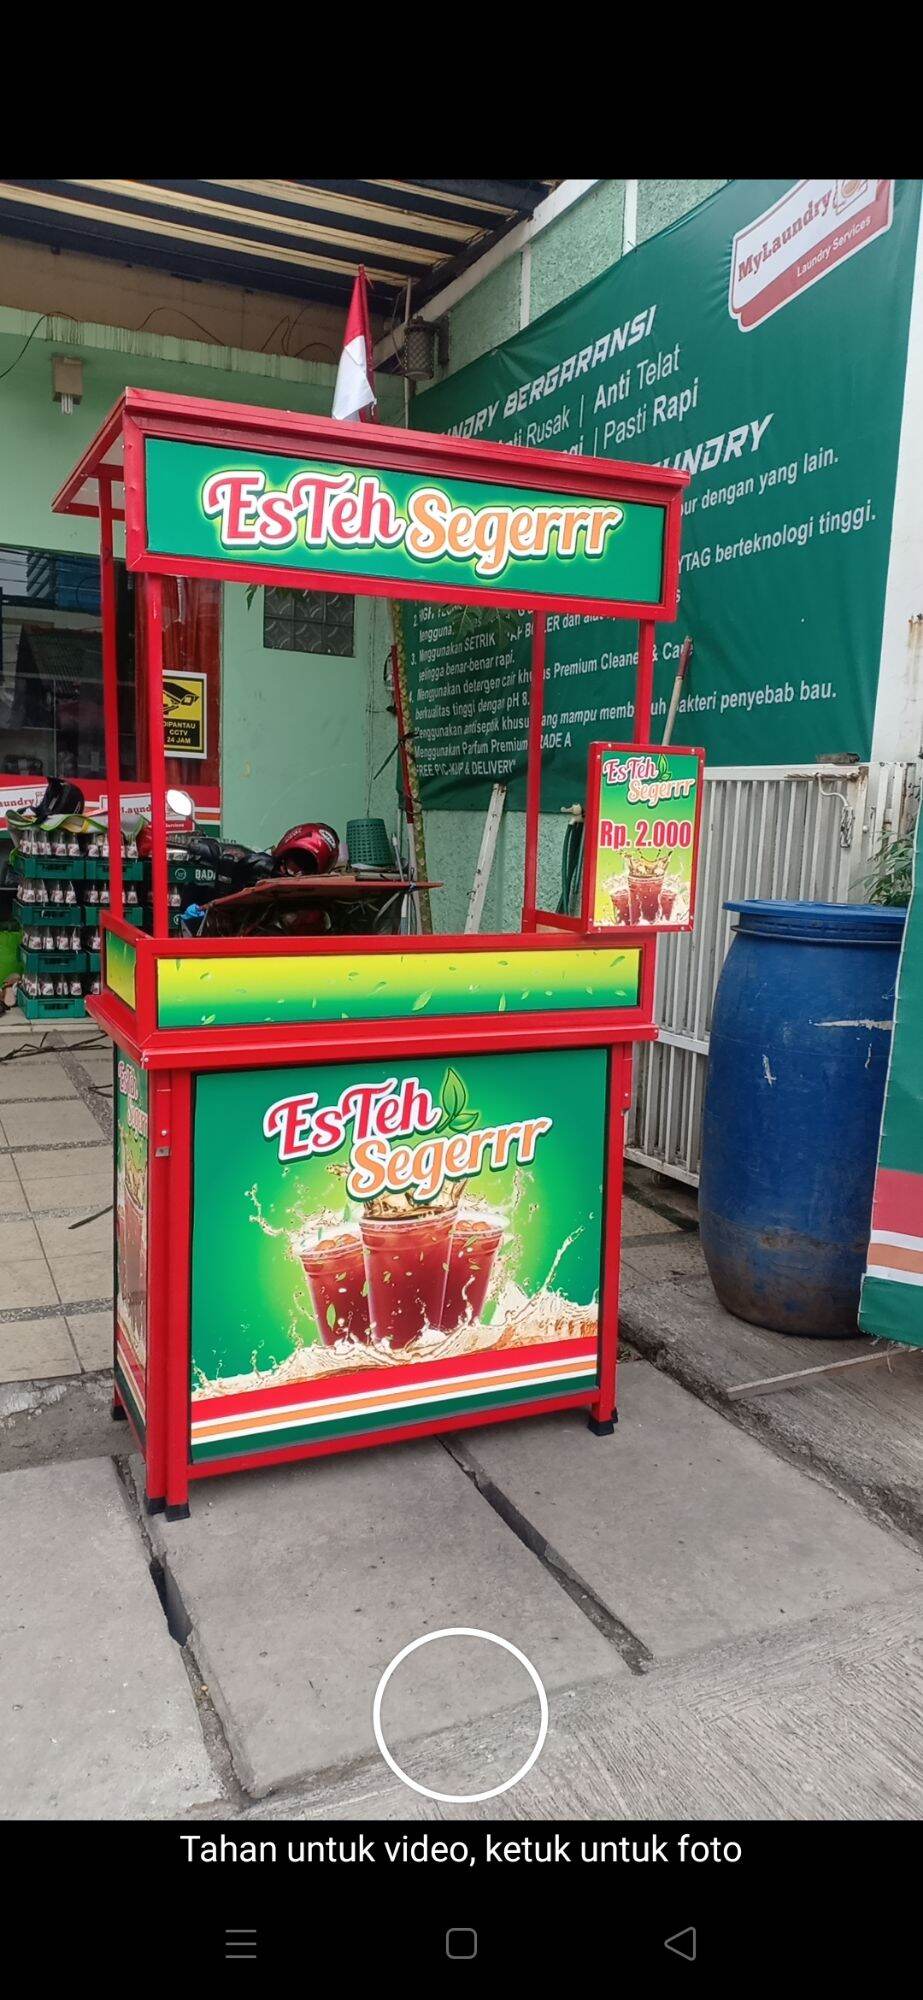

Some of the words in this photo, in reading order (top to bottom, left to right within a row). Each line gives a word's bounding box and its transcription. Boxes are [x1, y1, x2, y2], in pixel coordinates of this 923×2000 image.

[738, 190, 832, 282] MyLaundry
[797, 246, 832, 277] Laundry
[832, 216, 871, 250] Services
[503, 304, 657, 420] BERGARANSI
[526, 405, 570, 448] Rusak
[594, 369, 631, 414] Anti
[637, 342, 681, 390] Telat
[603, 403, 647, 450] Pasti
[653, 377, 699, 426] Rapi
[701, 477, 754, 510] dengan
[759, 461, 798, 495] yang
[803, 447, 839, 475] lain.
[406, 487, 622, 576] Segerrr
[715, 516, 815, 563] berteknologi
[819, 499, 876, 534] tinggi.
[495, 650, 515, 669] rapi.
[501, 671, 516, 687] cair
[554, 657, 597, 679] Premium
[453, 702, 476, 718] tinggi
[507, 691, 519, 711] pH
[560, 708, 597, 727] mampu
[720, 682, 794, 713] penyebab
[800, 680, 837, 701] bau.
[166, 736, 175, 744] 24
[169, 729, 188, 737] CCTV
[462, 740, 488, 755] Parfum
[491, 737, 528, 753] Premium
[564, 732, 572, 748] A
[627, 778, 696, 807] Segerrr
[599, 819, 631, 849] Rp.
[634, 820, 692, 849] 2.000
[347, 1117, 553, 1200] Segerrr
